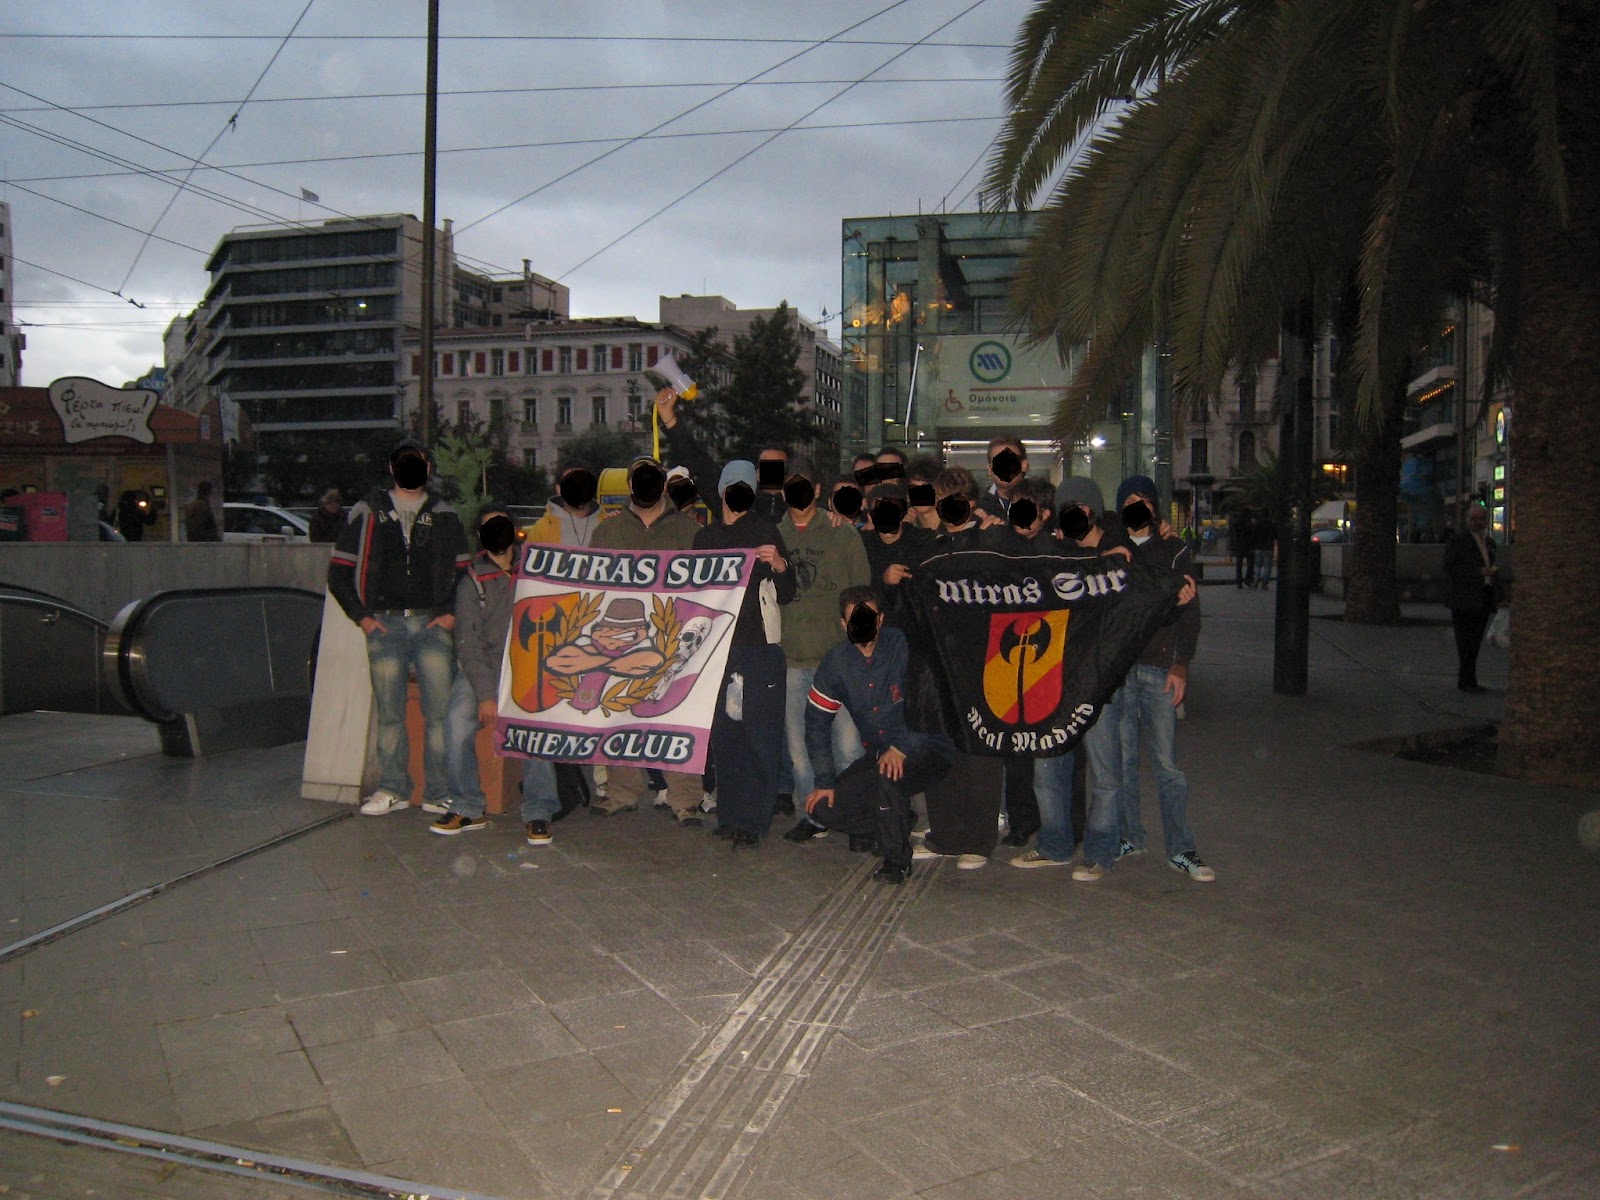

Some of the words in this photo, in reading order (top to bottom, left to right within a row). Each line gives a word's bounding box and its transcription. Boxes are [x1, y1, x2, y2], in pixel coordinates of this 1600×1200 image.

[969, 393, 1016, 403] Ομόνοια
[524, 548, 656, 585] ULTRAS
[665, 553, 744, 586] SUR
[936, 577, 1042, 604] Ultras
[1051, 568, 1127, 600] Sur
[967, 706, 1004, 750] Real
[1012, 703, 1095, 752] Madrid
[602, 732, 691, 760] CLUB
